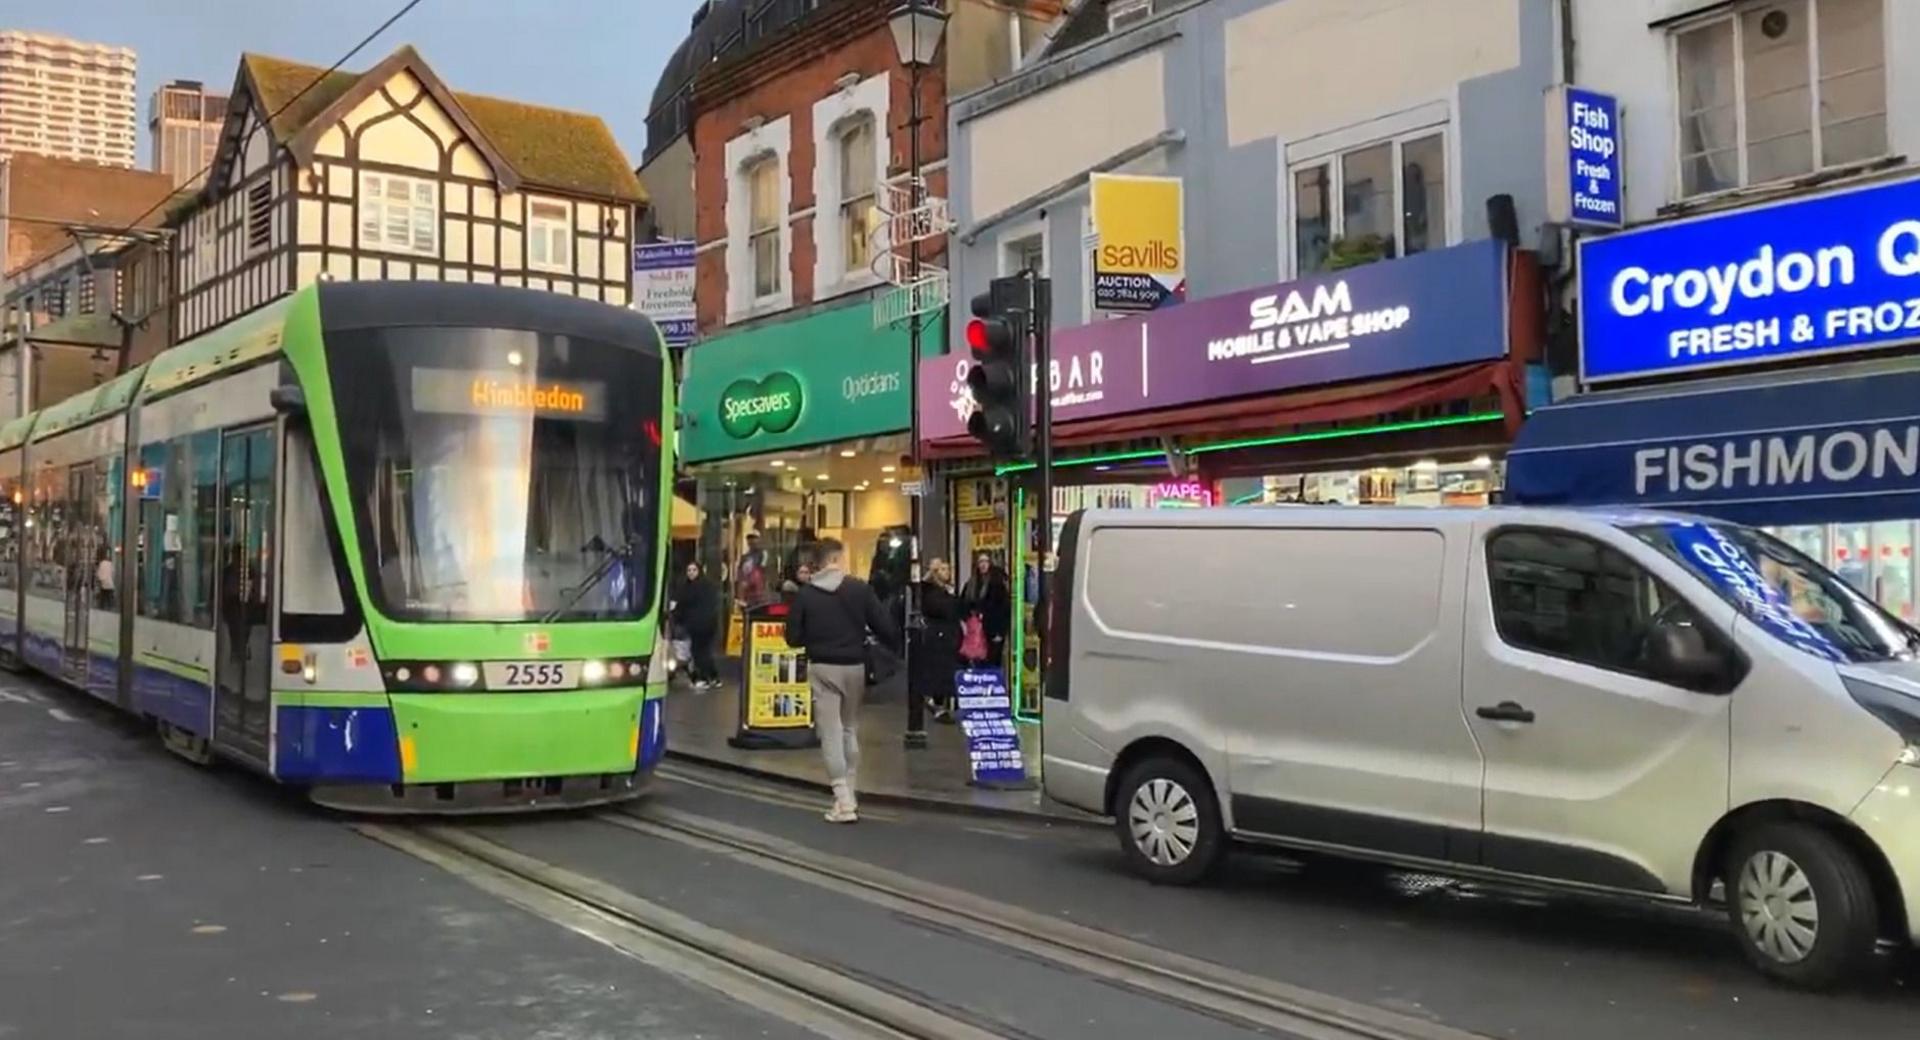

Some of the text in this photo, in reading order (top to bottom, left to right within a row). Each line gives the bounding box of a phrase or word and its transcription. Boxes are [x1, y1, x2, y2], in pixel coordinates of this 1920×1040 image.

[1573, 102, 1609, 130] Fish
[1570, 125, 1614, 159] Shop
[1576, 159, 1611, 180] Fresh
[1588, 179, 1599, 194] &
[1103, 240, 1178, 269] savills
[647, 286, 692, 299] Freehold
[1097, 276, 1151, 288] AUCTION
[1097, 288, 1116, 298] 020
[1611, 243, 1856, 317] Croydon
[1250, 280, 1352, 330] SAM
[1208, 305, 1411, 361] MOBILE & VAPE SHOP
[1669, 318, 1779, 359] FRESH
[1791, 315, 1814, 343] &
[472, 380, 583, 411] Wimbledon
[842, 372, 899, 402] Opticians
[724, 392, 792, 422] Specsavers
[1635, 426, 1920, 495] FISHMON
[1158, 483, 1201, 500] VAPE
[506, 664, 564, 686] 2555
[963, 673, 998, 684] Croydon
